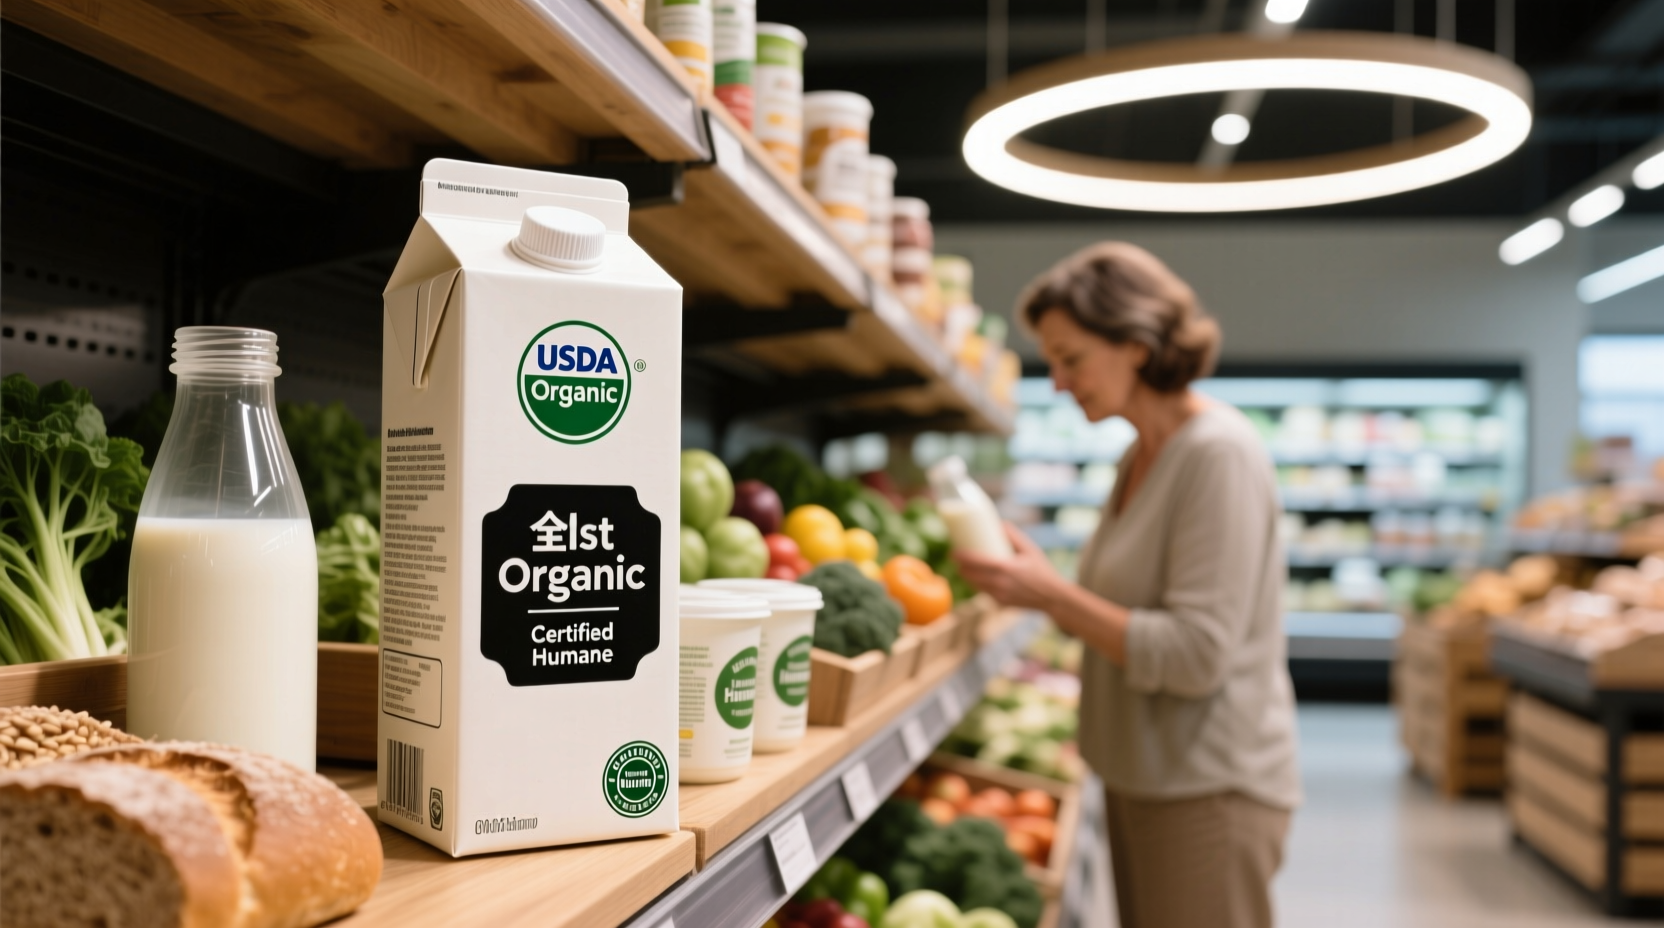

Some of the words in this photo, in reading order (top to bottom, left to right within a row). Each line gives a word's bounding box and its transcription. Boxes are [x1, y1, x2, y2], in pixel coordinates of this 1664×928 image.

[537, 344, 618, 374] USDA
[531, 379, 618, 408] Organic
[499, 553, 646, 603] Organic
[531, 621, 614, 644] Certified
[532, 648, 614, 667] Humane
